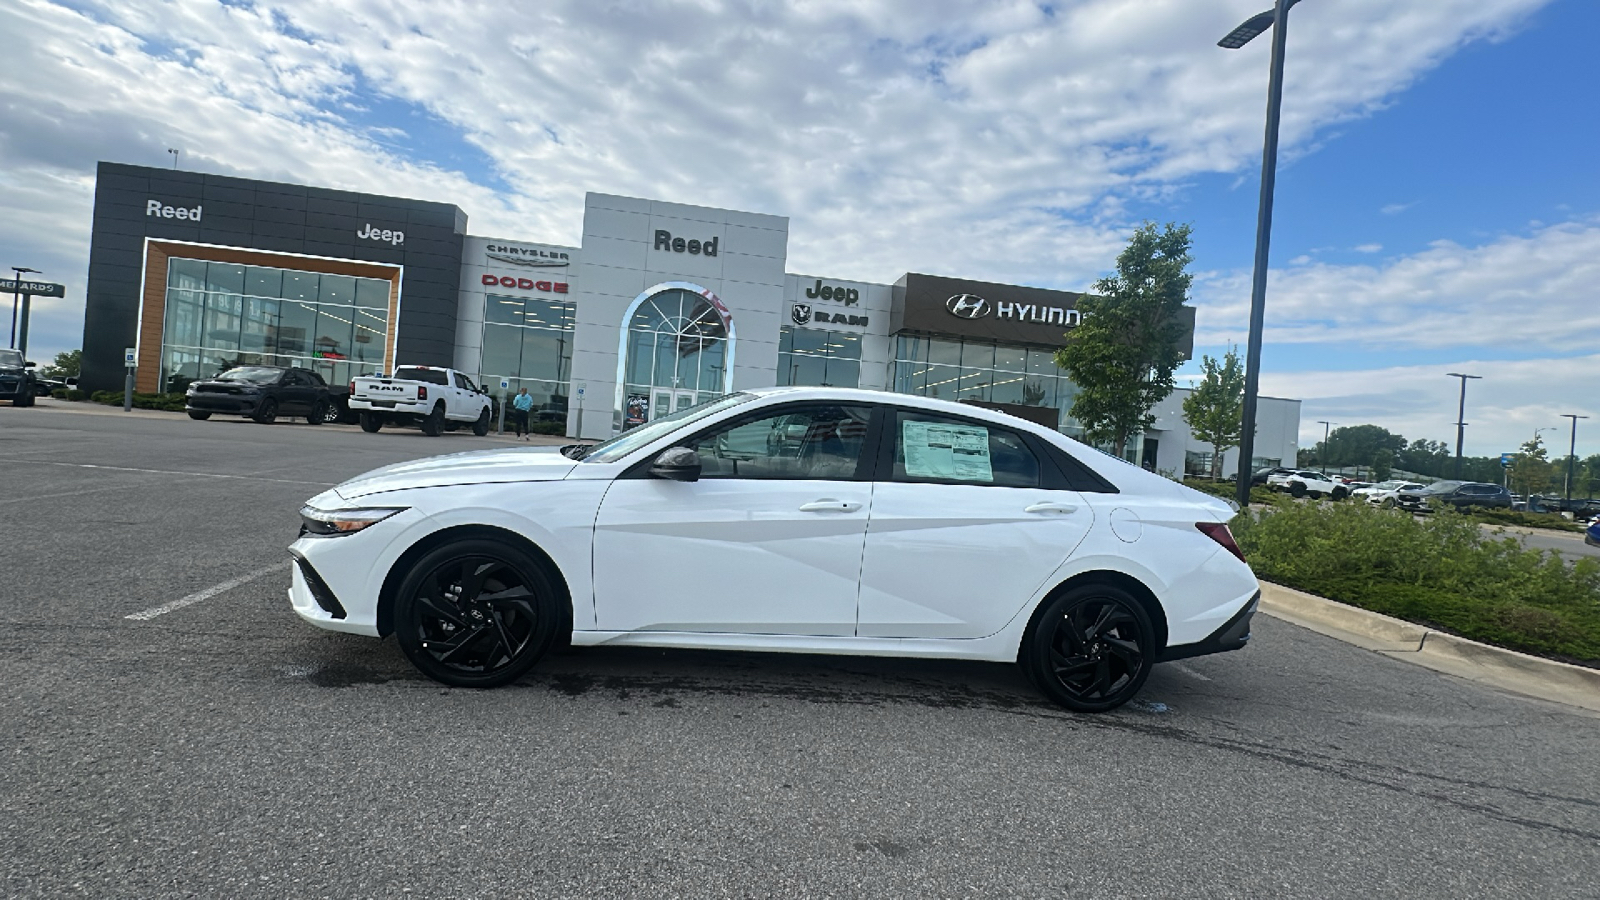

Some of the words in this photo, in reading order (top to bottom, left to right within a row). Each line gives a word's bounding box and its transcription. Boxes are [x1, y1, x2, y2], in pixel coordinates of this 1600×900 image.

[146, 200, 203, 222] Reed
[357, 223, 404, 246] Jeep
[654, 229, 719, 257] Reed
[486, 244, 569, 260] CHRYSLER
[481, 274, 569, 294] DODGE
[806, 280, 859, 307] Jeep
[814, 311, 869, 327] RAM
[997, 301, 1092, 327] HYUND
[369, 384, 404, 392] RAM
